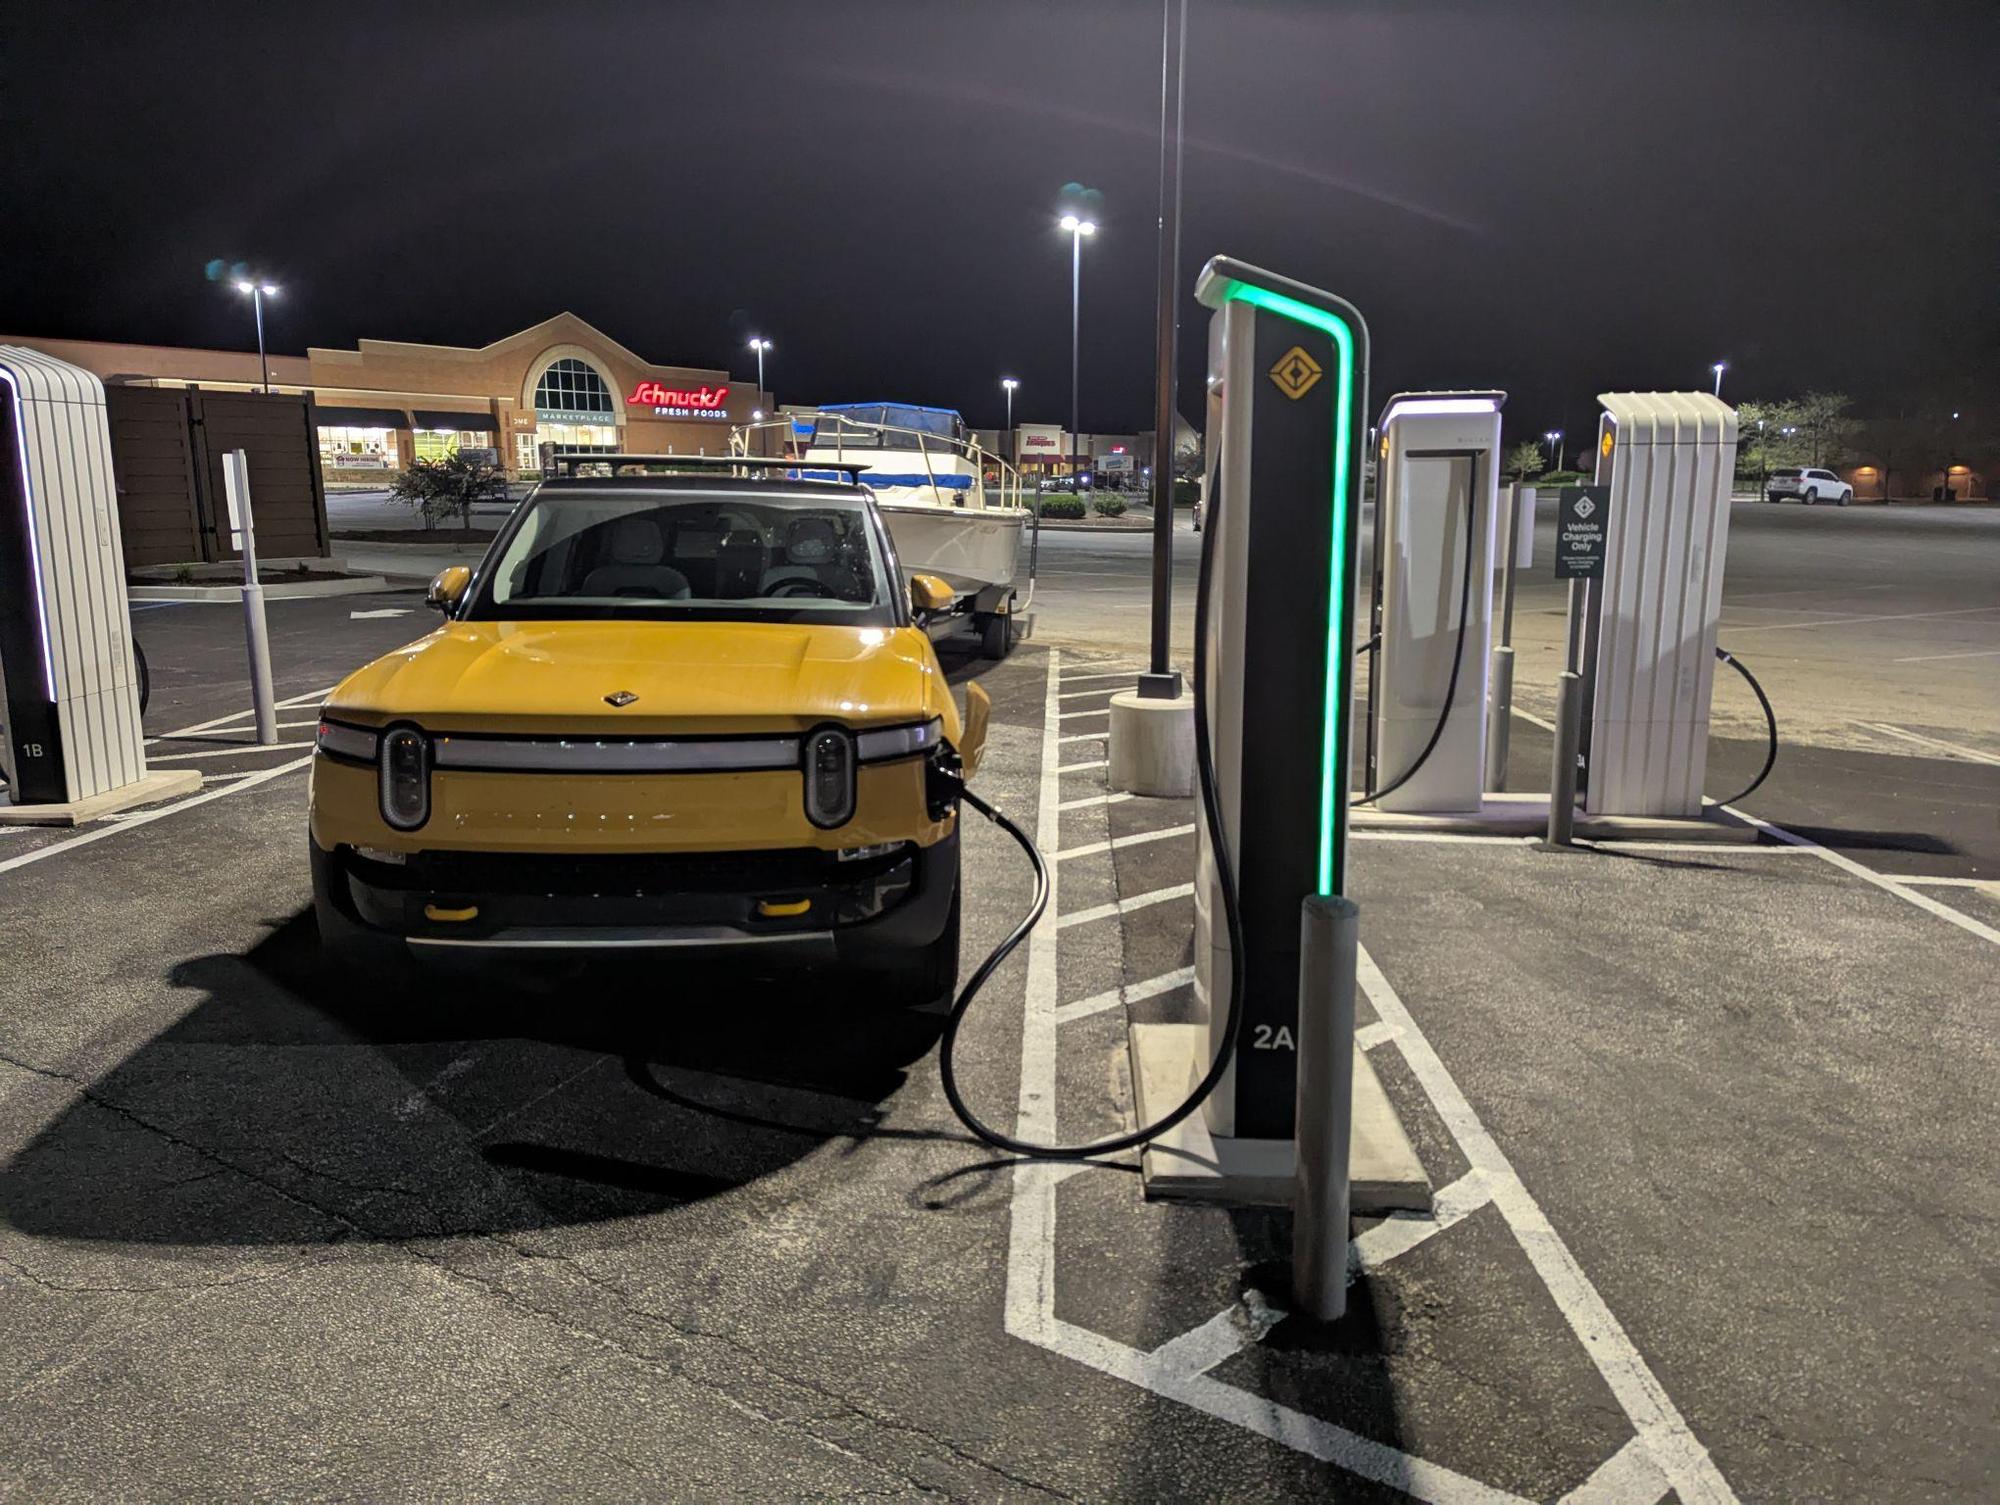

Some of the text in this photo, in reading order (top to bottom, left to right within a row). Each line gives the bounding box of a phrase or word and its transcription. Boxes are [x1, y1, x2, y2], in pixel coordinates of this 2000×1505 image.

[627, 382, 729, 408] Schnucks
[542, 413, 609, 422] MARKETPLACE
[655, 407, 728, 418] FRESH FOODS
[1567, 523, 1599, 531] Vehicle
[1562, 532, 1602, 542] Charging
[1571, 542, 1592, 552] Only
[23, 743, 44, 758] 1B
[1253, 1024, 1295, 1051] 2A
